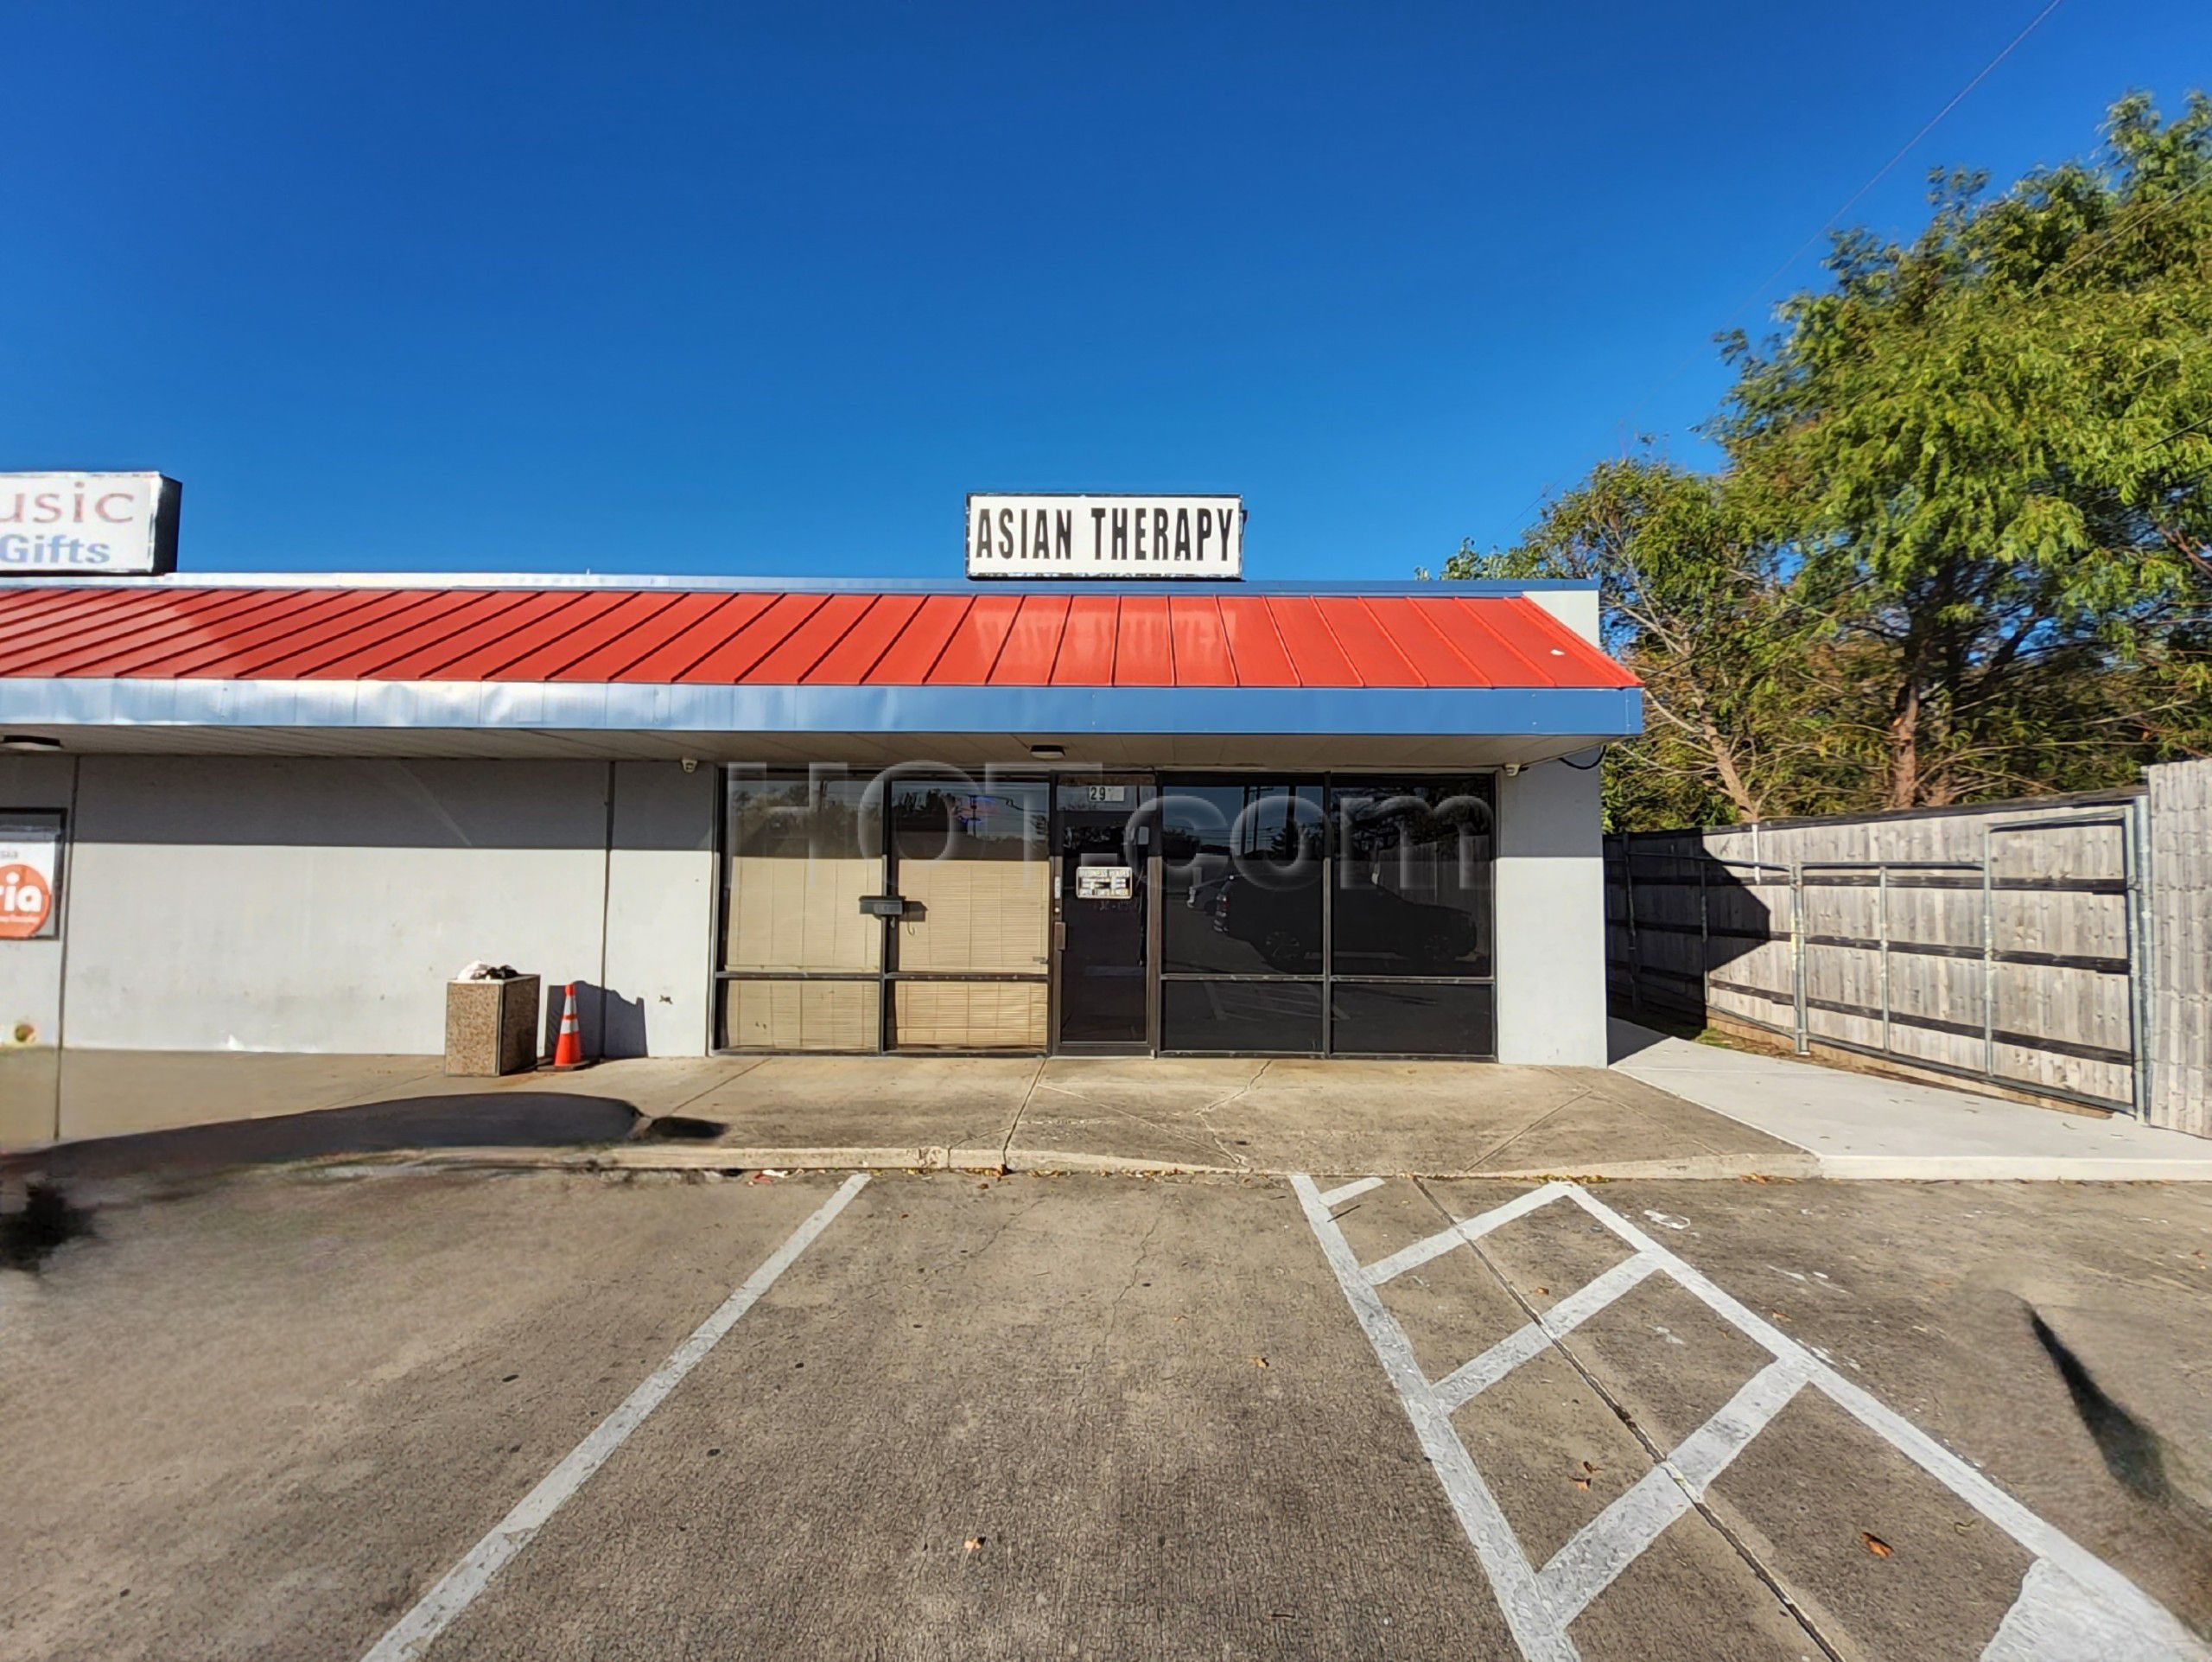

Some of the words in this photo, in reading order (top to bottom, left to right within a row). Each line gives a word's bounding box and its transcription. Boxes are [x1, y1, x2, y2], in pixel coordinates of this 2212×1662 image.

[0, 534, 111, 564] Gifts
[976, 508, 1072, 560] ASIAN
[1090, 507, 1234, 562] THERAPY
